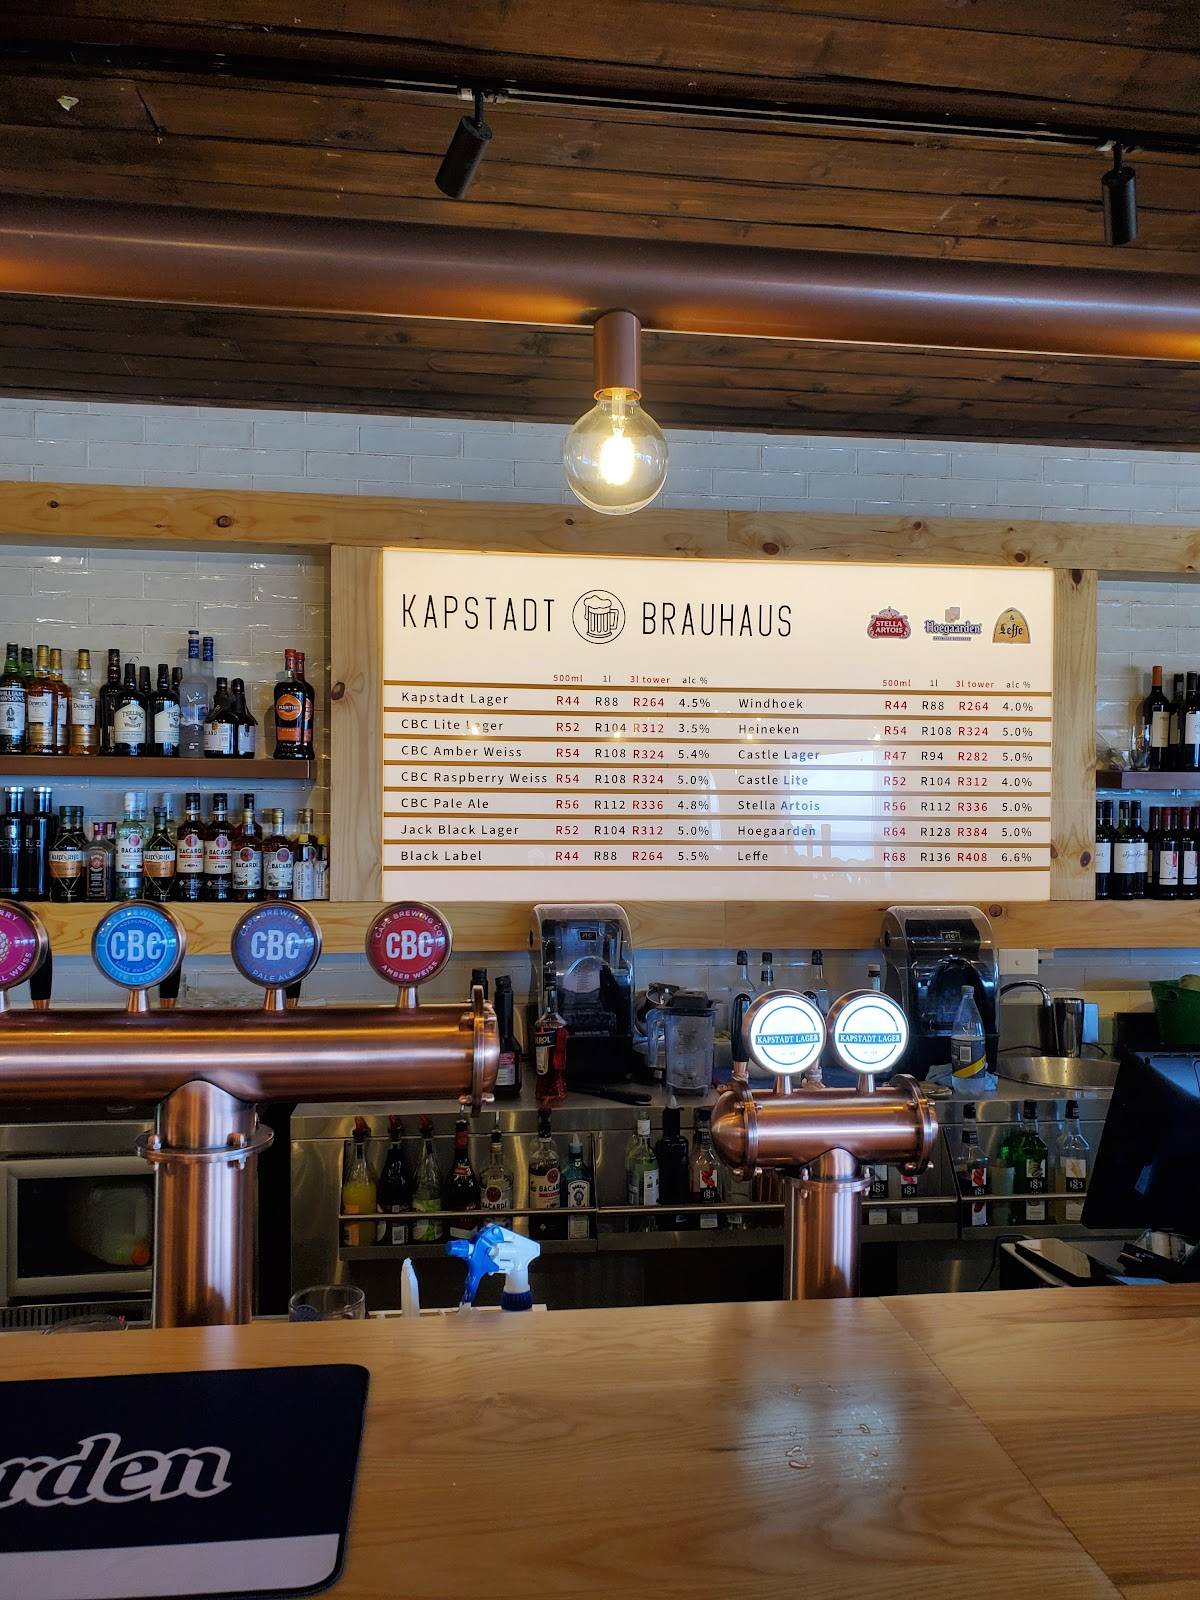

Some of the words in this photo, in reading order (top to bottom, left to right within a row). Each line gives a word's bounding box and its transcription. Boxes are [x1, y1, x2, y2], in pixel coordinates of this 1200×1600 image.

[403, 594, 555, 632] KAPSTADT
[642, 602, 792, 637] BRAUHAUS
[876, 620, 902, 628] STELLA
[925, 620, 982, 636] Hoegaarden
[1000, 624, 1023, 638] Leffe
[683, 676, 696, 684] alc
[700, 677, 707, 686] %
[402, 692, 464, 704] Kapstadt
[471, 694, 508, 706] Lager
[557, 696, 579, 705] R44
[596, 697, 618, 706] R88
[634, 697, 664, 707] R264
[679, 698, 710, 707] 4.5%
[739, 698, 802, 708] Windhoek
[885, 701, 907, 710] R44
[922, 701, 944, 710] R88
[959, 702, 988, 711] R264
[1003, 702, 1033, 711] 4.0%
[402, 719, 427, 728] CBC
[435, 720, 460, 729] Lite
[557, 723, 579, 732] R52
[596, 723, 626, 732] R104
[633, 723, 663, 733] R312
[679, 724, 709, 733] 3.5%
[739, 724, 798, 734] Heineken
[885, 726, 906, 735] R54
[922, 727, 951, 735] R108
[959, 727, 987, 736] R324
[1003, 728, 1032, 736] 5.0%
[402, 746, 428, 755] CBC
[434, 746, 478, 756] Amber
[484, 747, 521, 757] Weiss
[557, 748, 579, 757] R54
[595, 749, 625, 758] R108
[634, 750, 664, 759] R324
[678, 750, 709, 758] 5.4%
[739, 750, 778, 759] Castle
[785, 750, 819, 762] Lager
[885, 751, 906, 760] R47
[922, 752, 943, 760] R94
[958, 752, 987, 761] R282
[1003, 753, 1032, 761] 5.0%
[402, 772, 427, 781] CBC
[434, 772, 504, 785] Raspberry
[510, 773, 547, 783] Weiss
[557, 774, 579, 783] R54
[595, 775, 625, 783] R108
[633, 775, 663, 783] R324
[678, 776, 710, 786] 5.0%
[738, 775, 778, 784] Castle
[784, 775, 808, 785] Lite
[884, 776, 906, 786] R52
[921, 777, 950, 786] R104
[958, 777, 987, 786] R312
[1002, 778, 1032, 786] 4.0%
[402, 798, 427, 807] CBC
[434, 798, 462, 808] Pale
[468, 798, 488, 808] Ale
[556, 800, 579, 809] R56
[595, 801, 625, 809] R112
[633, 801, 663, 809] R336
[678, 801, 709, 810] 4.8%
[738, 800, 775, 810] Stella
[781, 801, 819, 811] Artois
[884, 802, 906, 811] R56
[921, 802, 950, 811] R112
[958, 802, 987, 811] R336
[1002, 803, 1032, 812] 5.0%
[401, 825, 432, 835] Jack
[439, 825, 475, 834] Black
[482, 825, 519, 837] Lager
[556, 826, 579, 834] R52
[595, 826, 625, 835] R104
[633, 826, 663, 835] R312
[678, 826, 709, 835] 5.0%
[738, 826, 815, 838] Hoegaarden
[884, 827, 906, 837] R64
[921, 828, 950, 836] R128
[958, 828, 987, 836] R384
[1002, 828, 1031, 836] 5.0%
[401, 851, 438, 860] Black
[445, 851, 481, 860] Label
[556, 852, 579, 860] R44
[594, 851, 616, 860] R88
[633, 851, 663, 860] R264
[678, 852, 709, 860] 5.5%
[738, 851, 768, 860] Leffe
[884, 852, 905, 861] R68
[921, 853, 950, 861] R136
[958, 853, 987, 861] R408
[1002, 852, 1031, 862] 6.6%
[375, 919, 392, 938] CAPE
[392, 910, 434, 924] BREWING
[111, 930, 162, 962] CBC
[251, 929, 300, 961] CBC
[386, 929, 433, 960] CBC
[9, 952, 32, 977] WEISS
[381, 964, 410, 980] AMBER
[412, 960, 438, 979] WEISS
[252, 968, 276, 982] PALE
[278, 969, 297, 982] ALE
[757, 1034, 794, 1044] KAPSTADT
[796, 1032, 819, 1043] LAGER
[840, 1034, 877, 1043] KAPSTADT
[878, 1034, 900, 1043] LAGER
